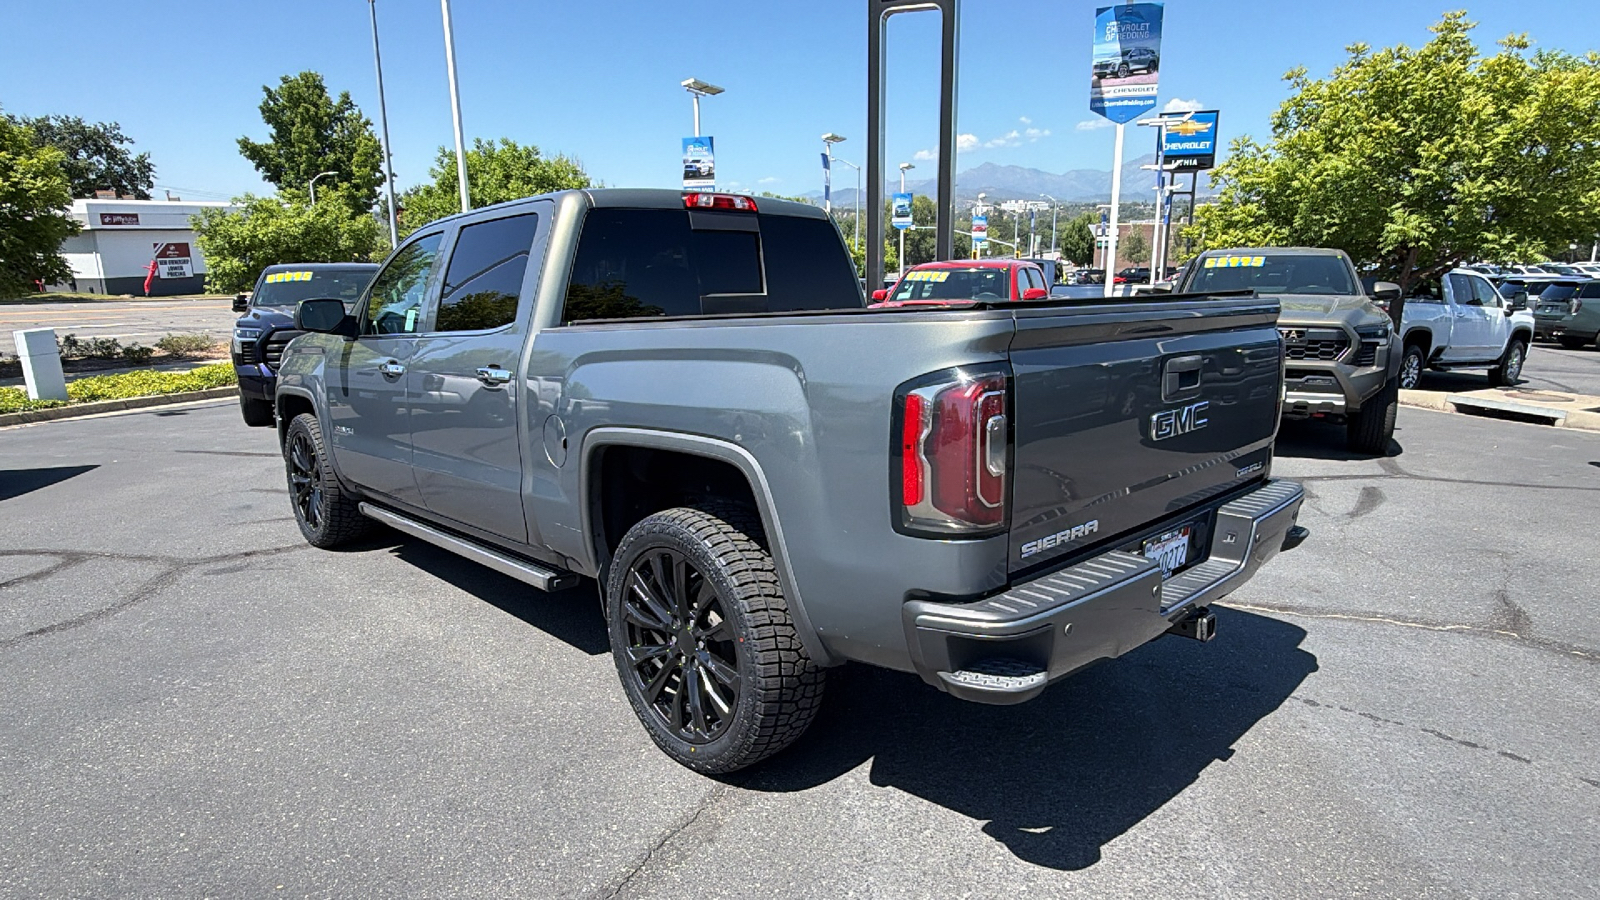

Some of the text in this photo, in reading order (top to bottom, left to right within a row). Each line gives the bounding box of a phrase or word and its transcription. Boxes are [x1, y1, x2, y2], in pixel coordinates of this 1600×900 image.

[1106, 22, 1150, 34] CHEVROLET
[1105, 31, 1150, 41] OF REDDING
[1113, 86, 1155, 94] CHEVROLET
[1164, 141, 1212, 151] CHEVROLET
[1150, 400, 1210, 441] GMC
[1021, 519, 1099, 559] SIERRA
